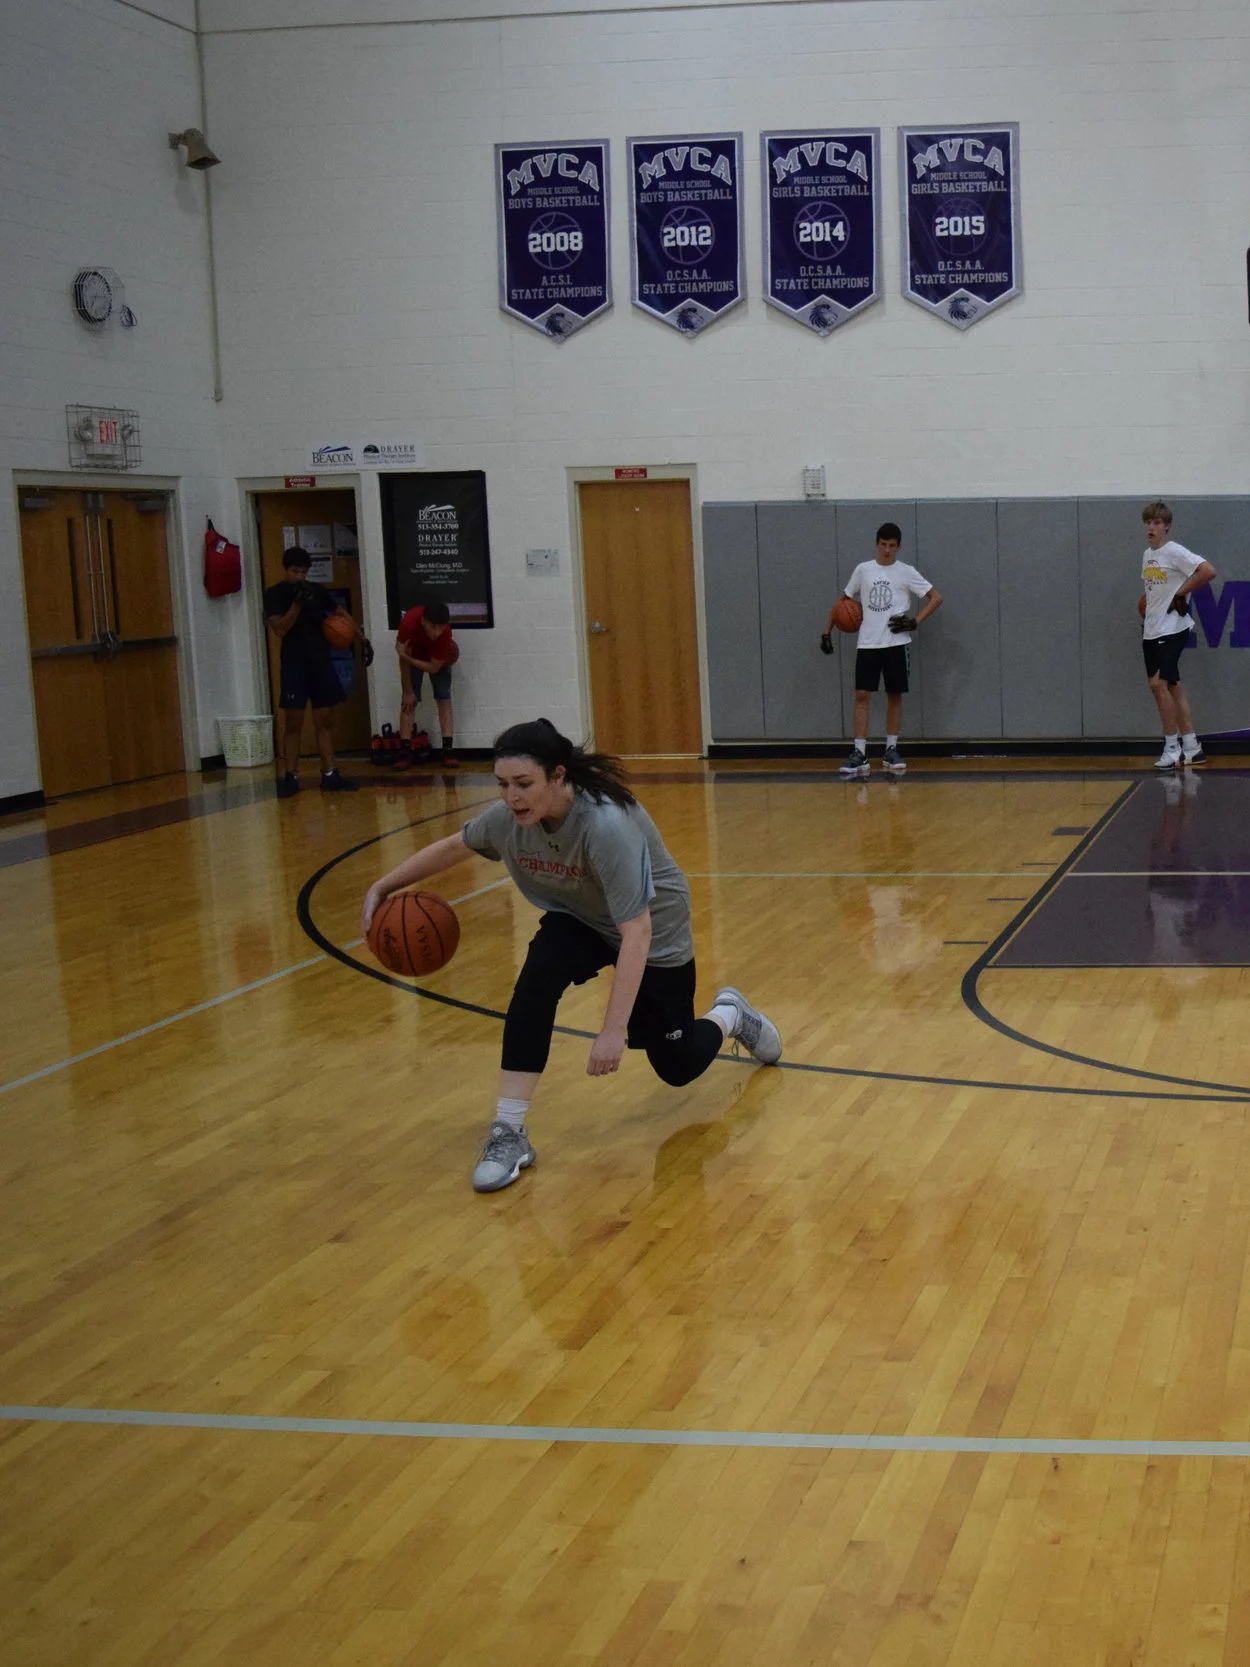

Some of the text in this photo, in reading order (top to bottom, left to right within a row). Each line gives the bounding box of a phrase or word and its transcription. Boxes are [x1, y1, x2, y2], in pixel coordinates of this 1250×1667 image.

[772, 142, 868, 184] MVCA
[913, 138, 1005, 179] MVCA
[507, 153, 600, 196] MVCA
[638, 146, 732, 189] MVCA
[794, 175, 847, 185] MIDDLE SCHOOL
[930, 171, 987, 181] MIDDLE SCHOOL
[528, 186, 579, 196] MIDDLE SCHOOL
[659, 180, 711, 189] MIDDLE SCHOOL
[772, 184, 869, 198] GIRLS BASKETBALL
[912, 180, 1007, 195] GIRLS BASKETBALL
[508, 195, 600, 209] BOYS BASKETBALL
[640, 189, 732, 204] BOYS BASKETBALL
[799, 221, 846, 242] 2014
[935, 216, 985, 237] 2015
[528, 232, 583, 252] 2008
[663, 225, 712, 247] 2012
[775, 277, 869, 290] STATE CHAMPIONS
[914, 271, 1008, 285] STATE CHAMPIONS
[512, 286, 603, 299] STATE CHAMPIONS
[643, 280, 734, 294] STATE CHAMPIONS
[99, 420, 118, 444] EXIT
[380, 445, 415, 453] DRAYER
[312, 452, 354, 464] BEACON
[418, 510, 457, 521] BEACON
[418, 534, 457, 543] DRAYER
